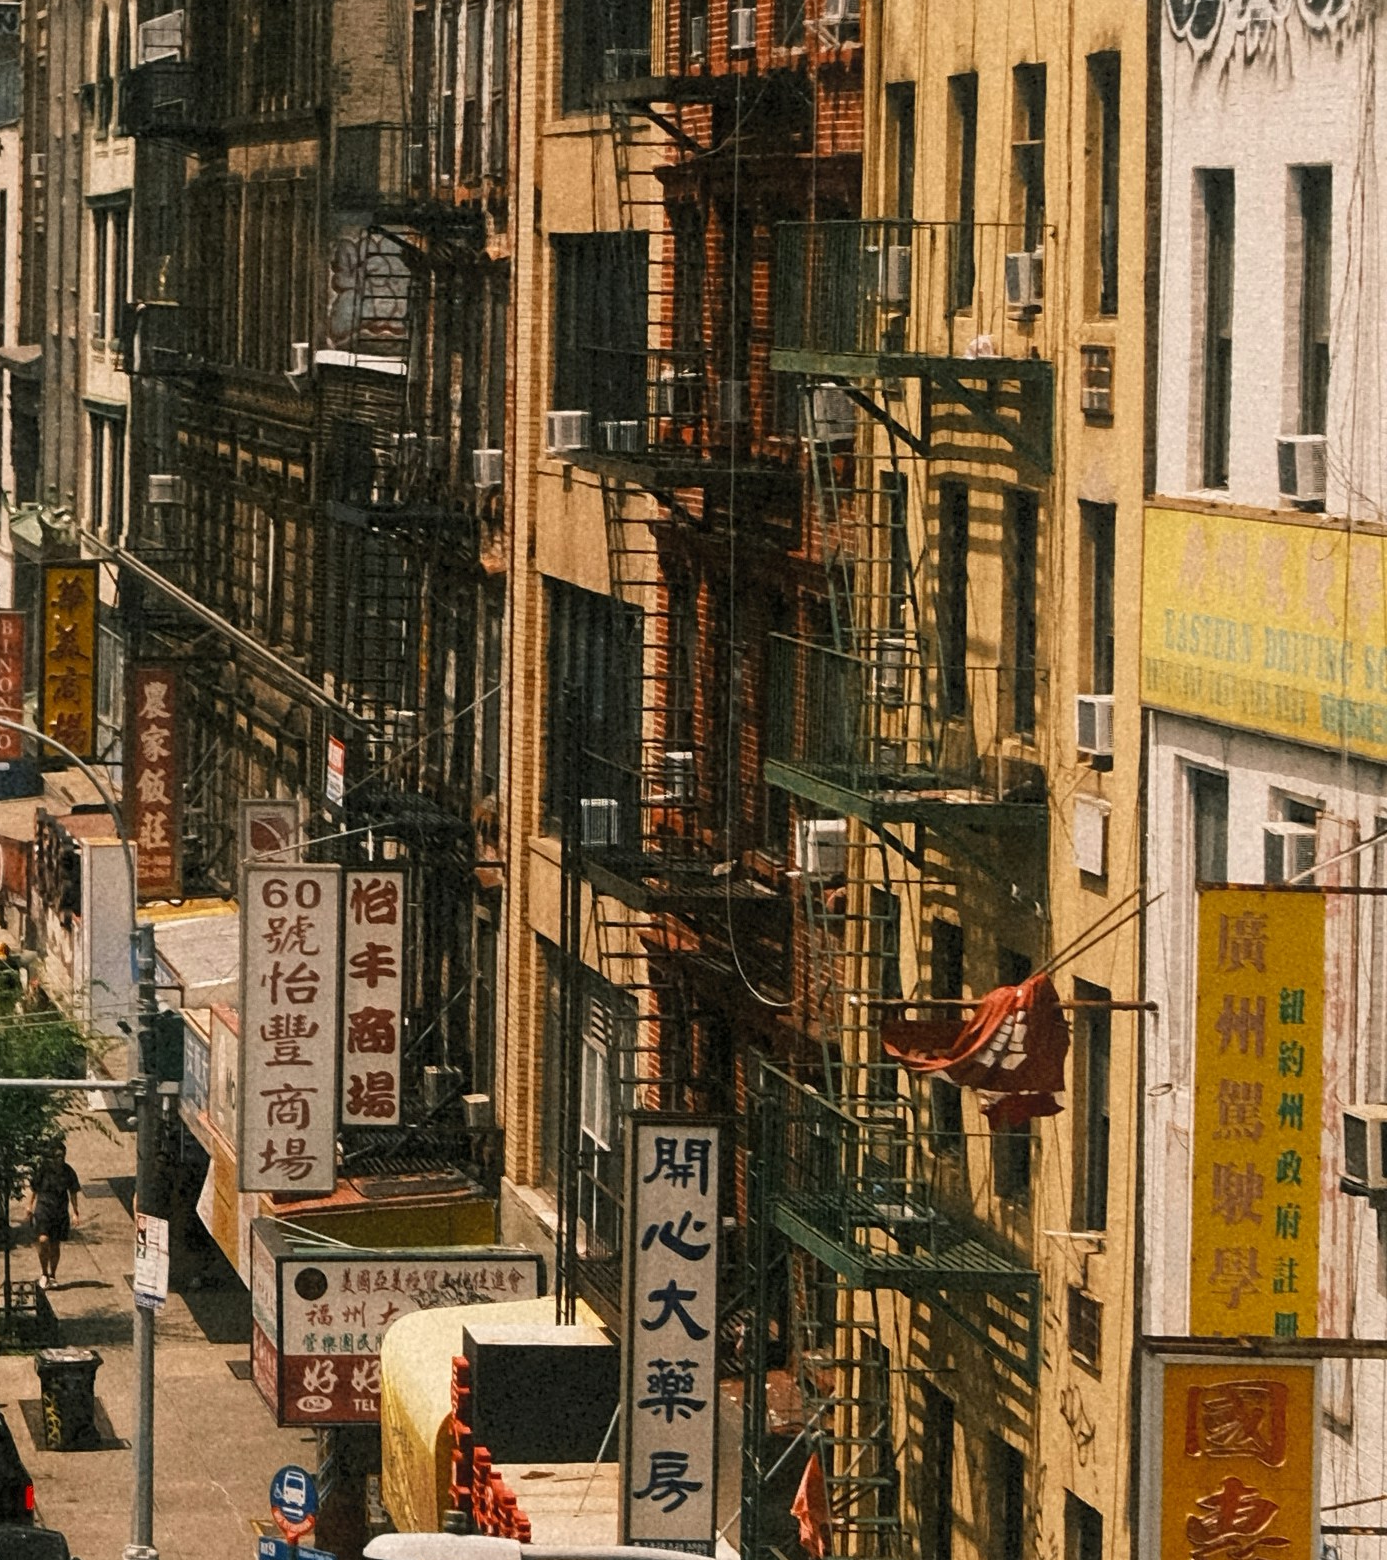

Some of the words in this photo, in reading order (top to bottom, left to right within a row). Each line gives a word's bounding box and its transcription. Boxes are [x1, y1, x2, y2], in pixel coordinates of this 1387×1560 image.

[1207, 909, 1269, 1336] 廣州駕駛學
[259, 1541, 276, 1557] M9
